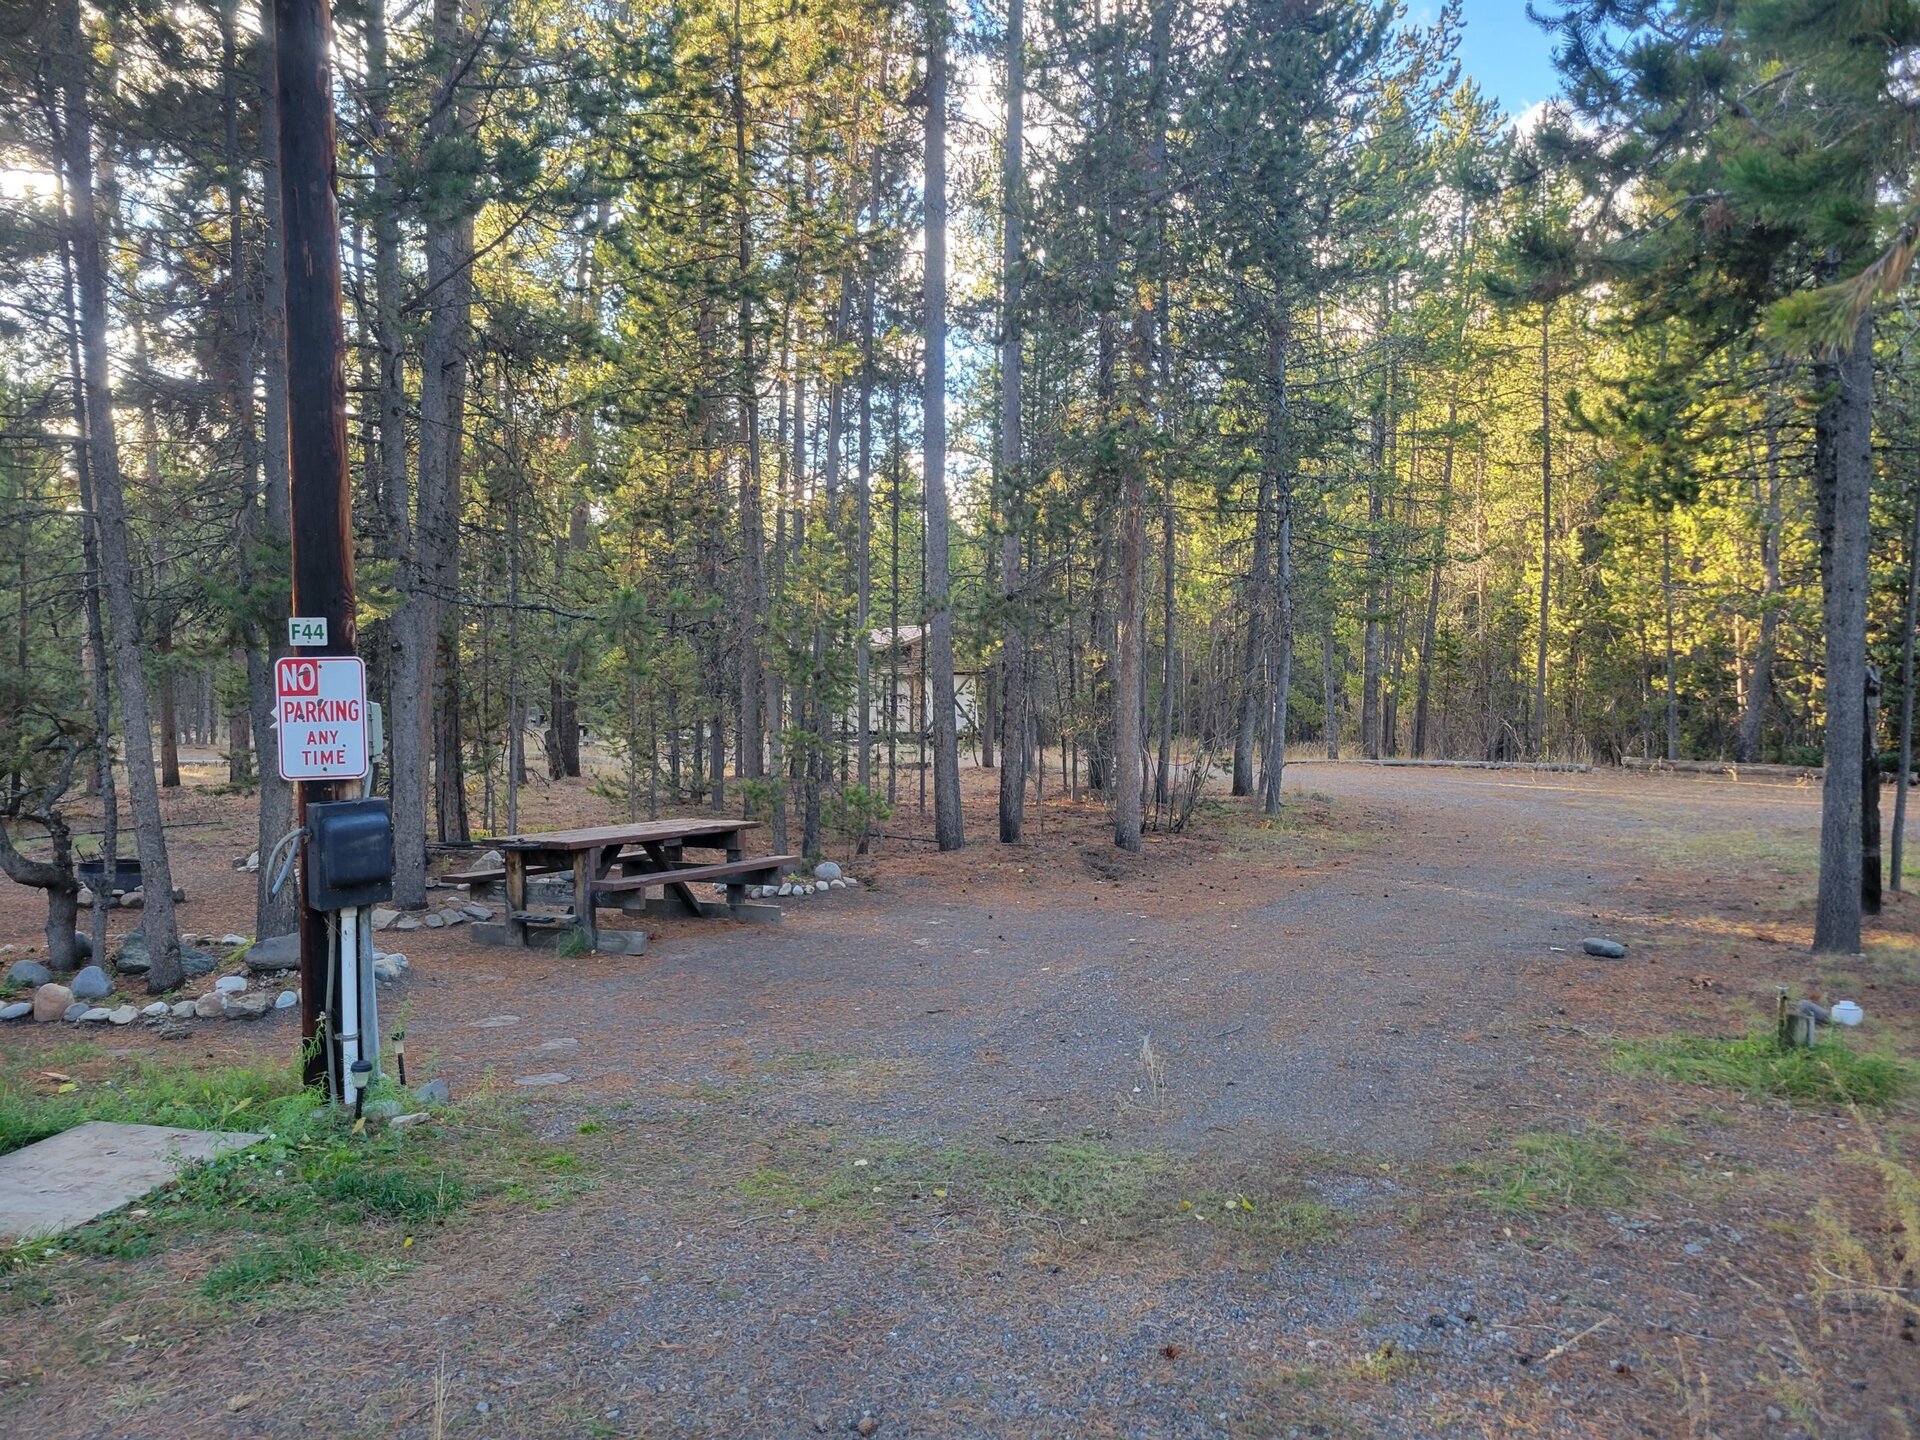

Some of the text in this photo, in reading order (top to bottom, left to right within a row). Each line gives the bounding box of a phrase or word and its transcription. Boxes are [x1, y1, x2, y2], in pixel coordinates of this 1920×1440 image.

[291, 623, 325, 640] F44
[281, 663, 316, 692] NO
[284, 700, 359, 723] PARKING
[307, 730, 339, 745] ANY
[302, 750, 346, 766] TIME
